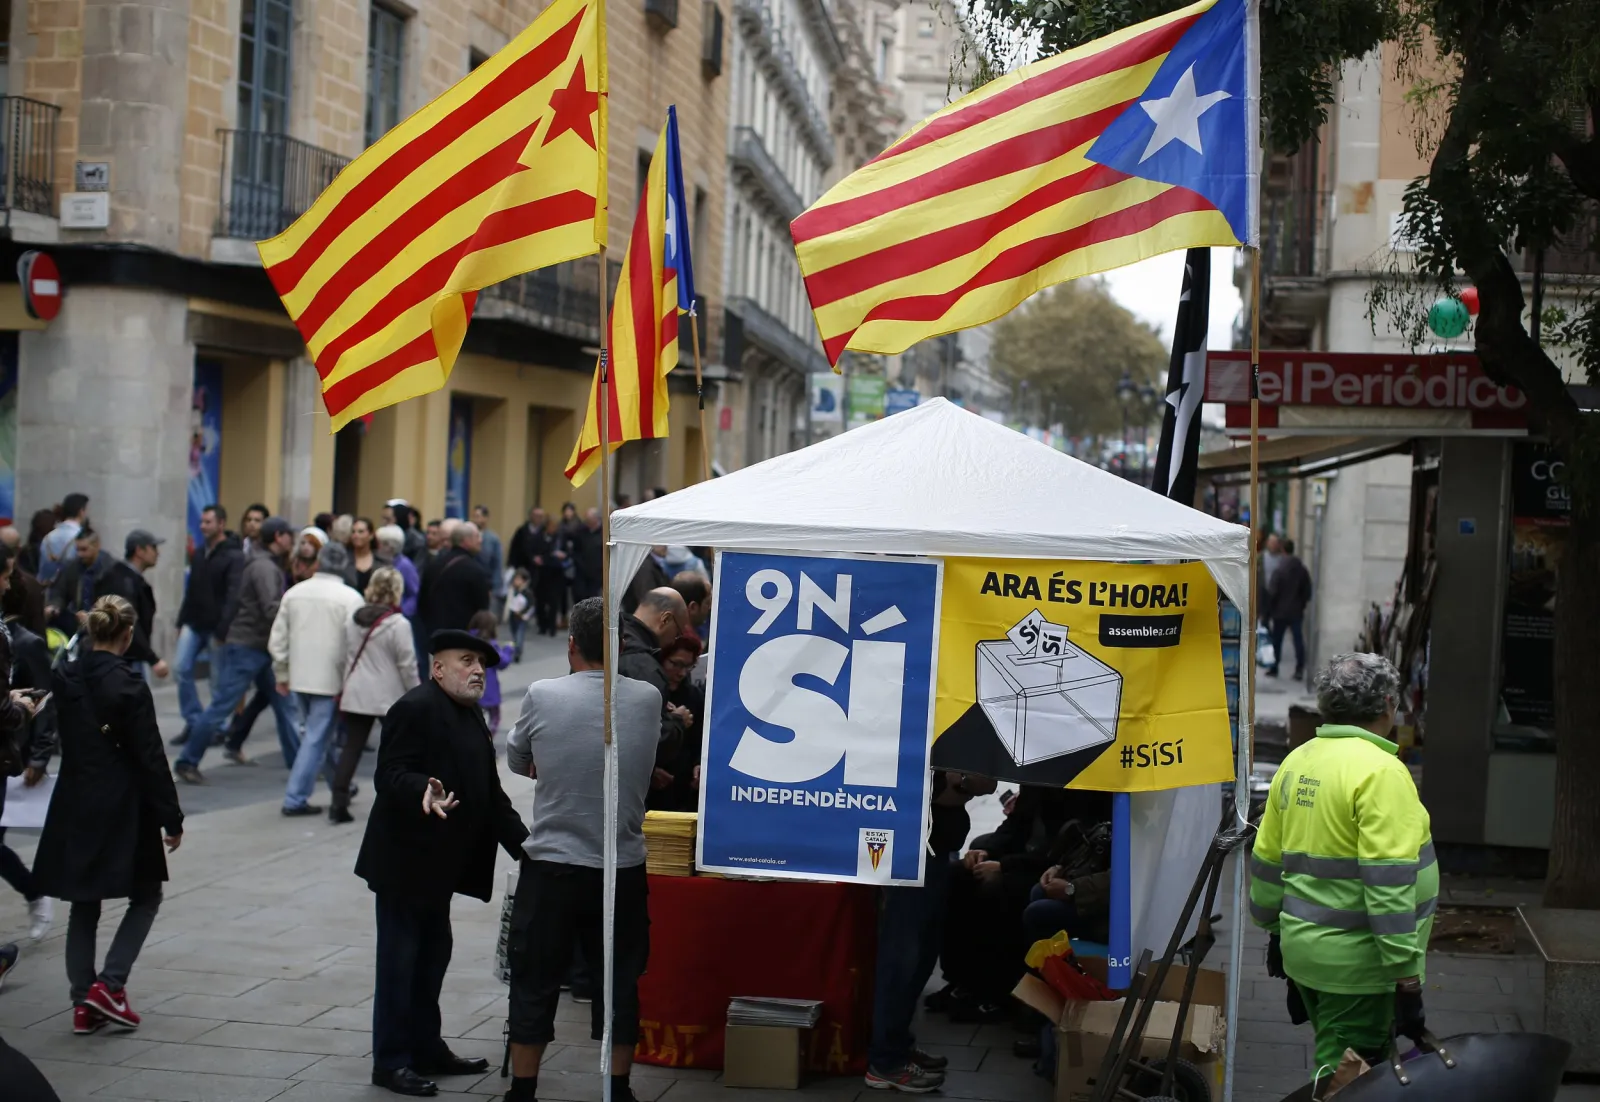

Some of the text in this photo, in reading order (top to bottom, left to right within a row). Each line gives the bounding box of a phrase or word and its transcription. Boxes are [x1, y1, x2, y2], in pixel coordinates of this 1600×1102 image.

[1257, 362, 1527, 409] el Periódico
[745, 568, 852, 635] 9N
[980, 571, 1188, 608] ARA ÉS L'HORA!
[1108, 625, 1177, 637] assemblea.cat
[728, 604, 907, 788] SÍ
[1120, 739, 1184, 768] #SíSí
[731, 785, 897, 812] INDEPENDÈNCIA
[729, 856, 787, 865] www.estat-catala.cat
